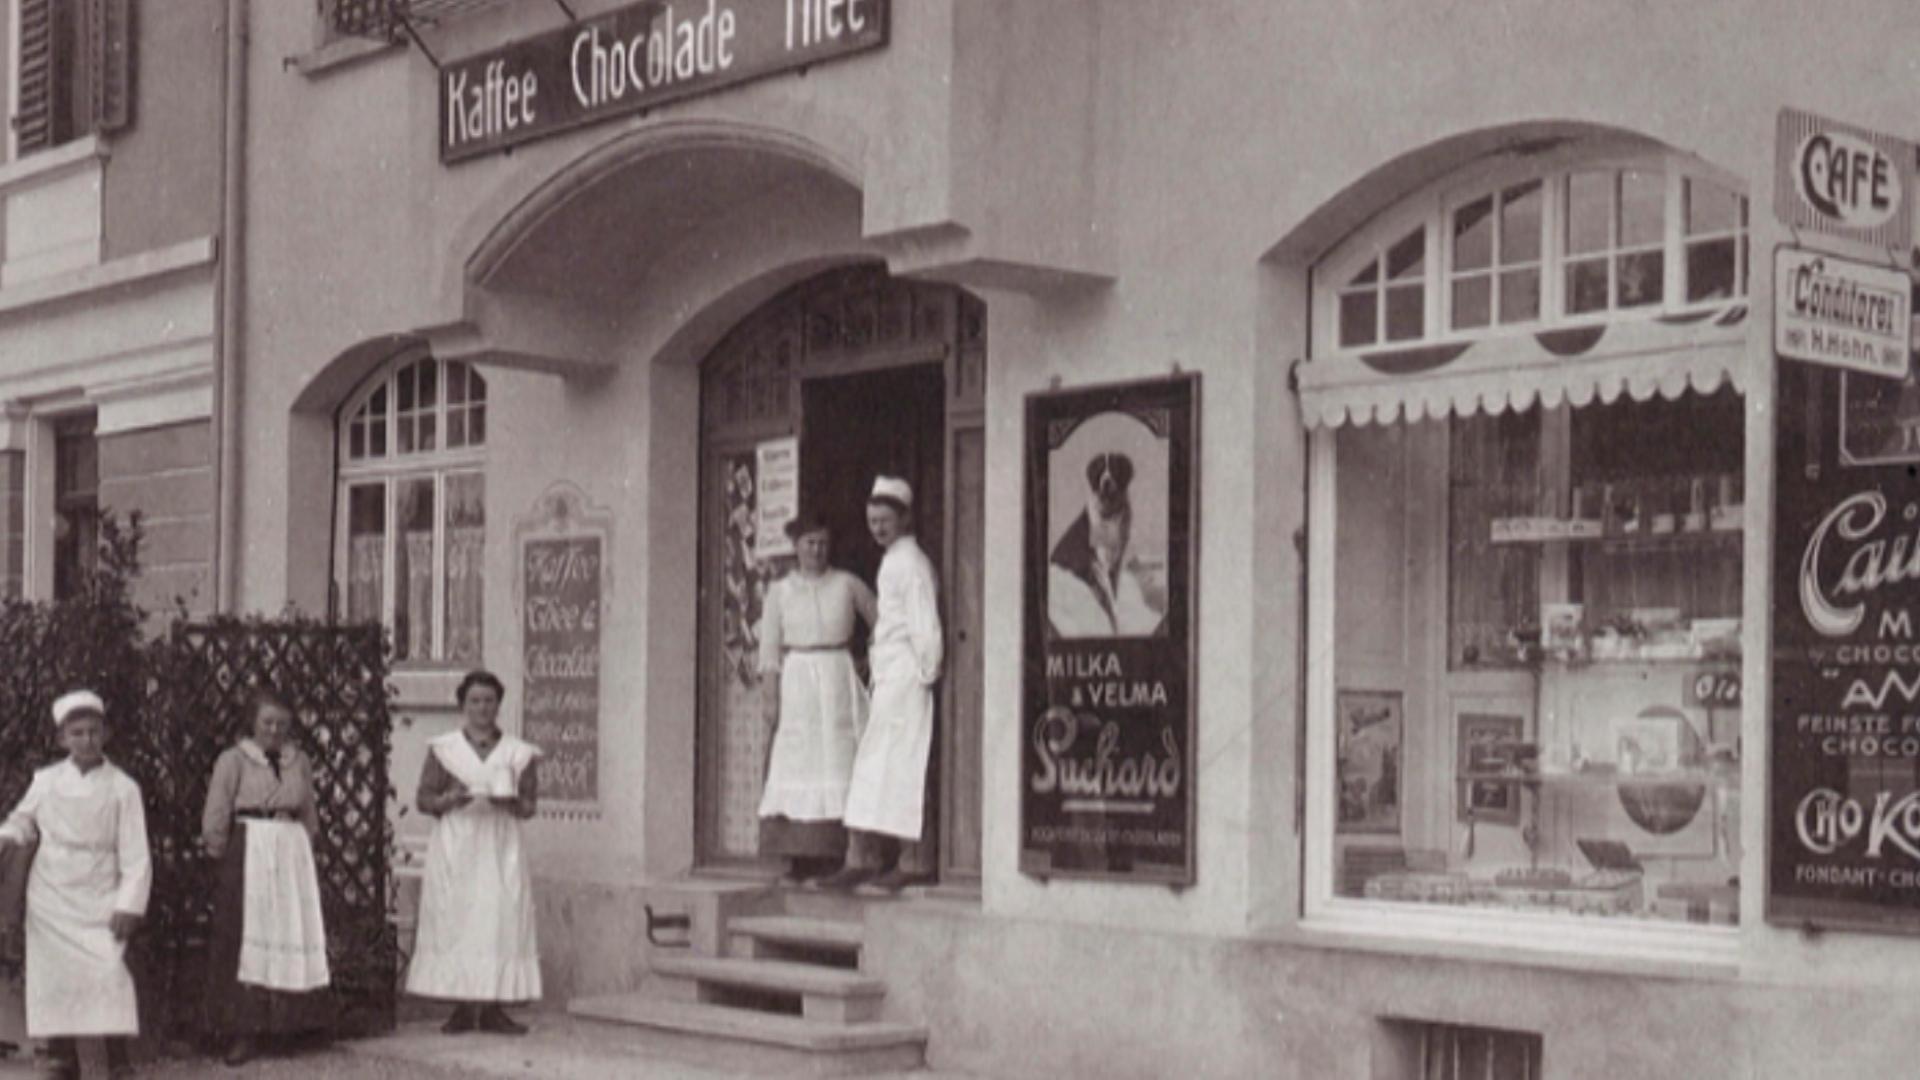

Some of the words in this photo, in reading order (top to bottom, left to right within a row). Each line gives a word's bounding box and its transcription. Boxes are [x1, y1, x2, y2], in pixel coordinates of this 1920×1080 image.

[447, 58, 537, 147] Kaffee
[571, 0, 736, 109] Chocolade
[1046, 652, 1122, 677] MILKA
[1088, 681, 1168, 706] VELMA
[1797, 713, 1890, 735] FEINSTE
[1031, 705, 1182, 798] Suchard
